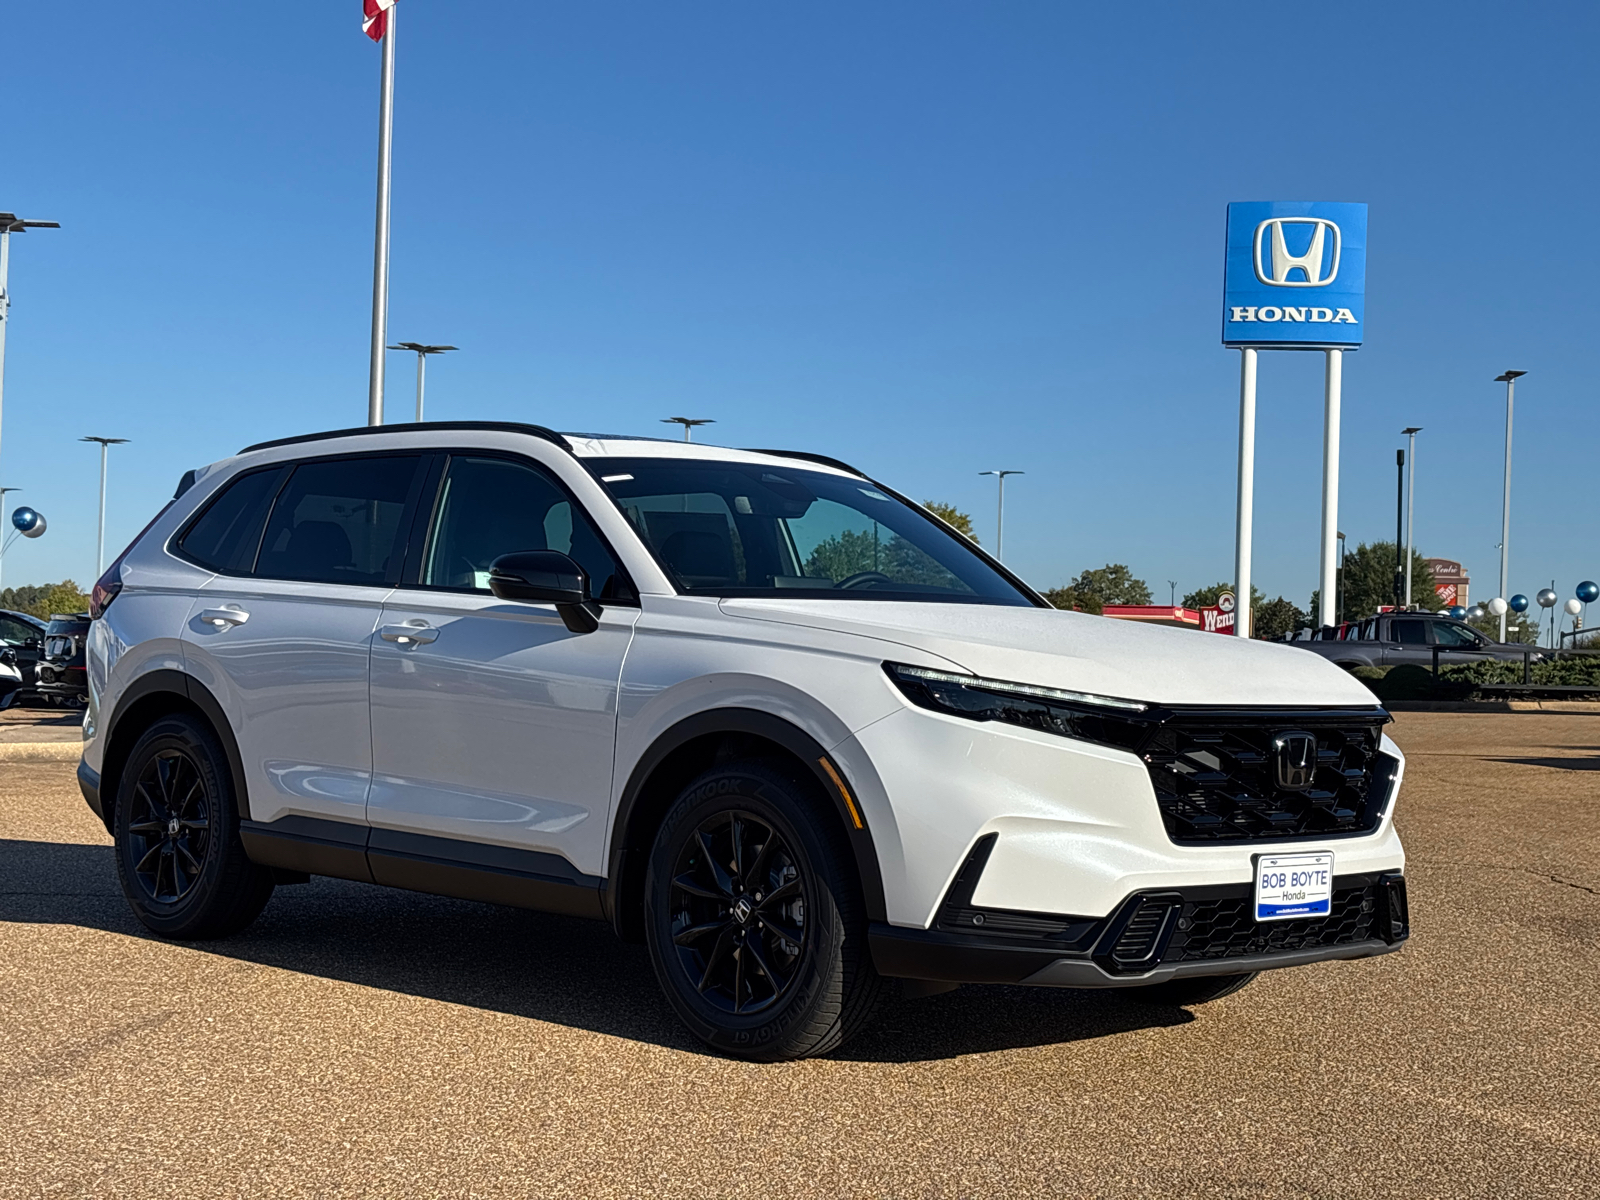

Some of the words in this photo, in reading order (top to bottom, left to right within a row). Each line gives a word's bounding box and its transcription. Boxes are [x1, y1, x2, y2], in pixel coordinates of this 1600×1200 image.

[1229, 306, 1358, 323] HONDA
[1262, 873, 1286, 889] BOB
[1291, 870, 1328, 887] BOYTE
[1282, 890, 1306, 901] Honda
